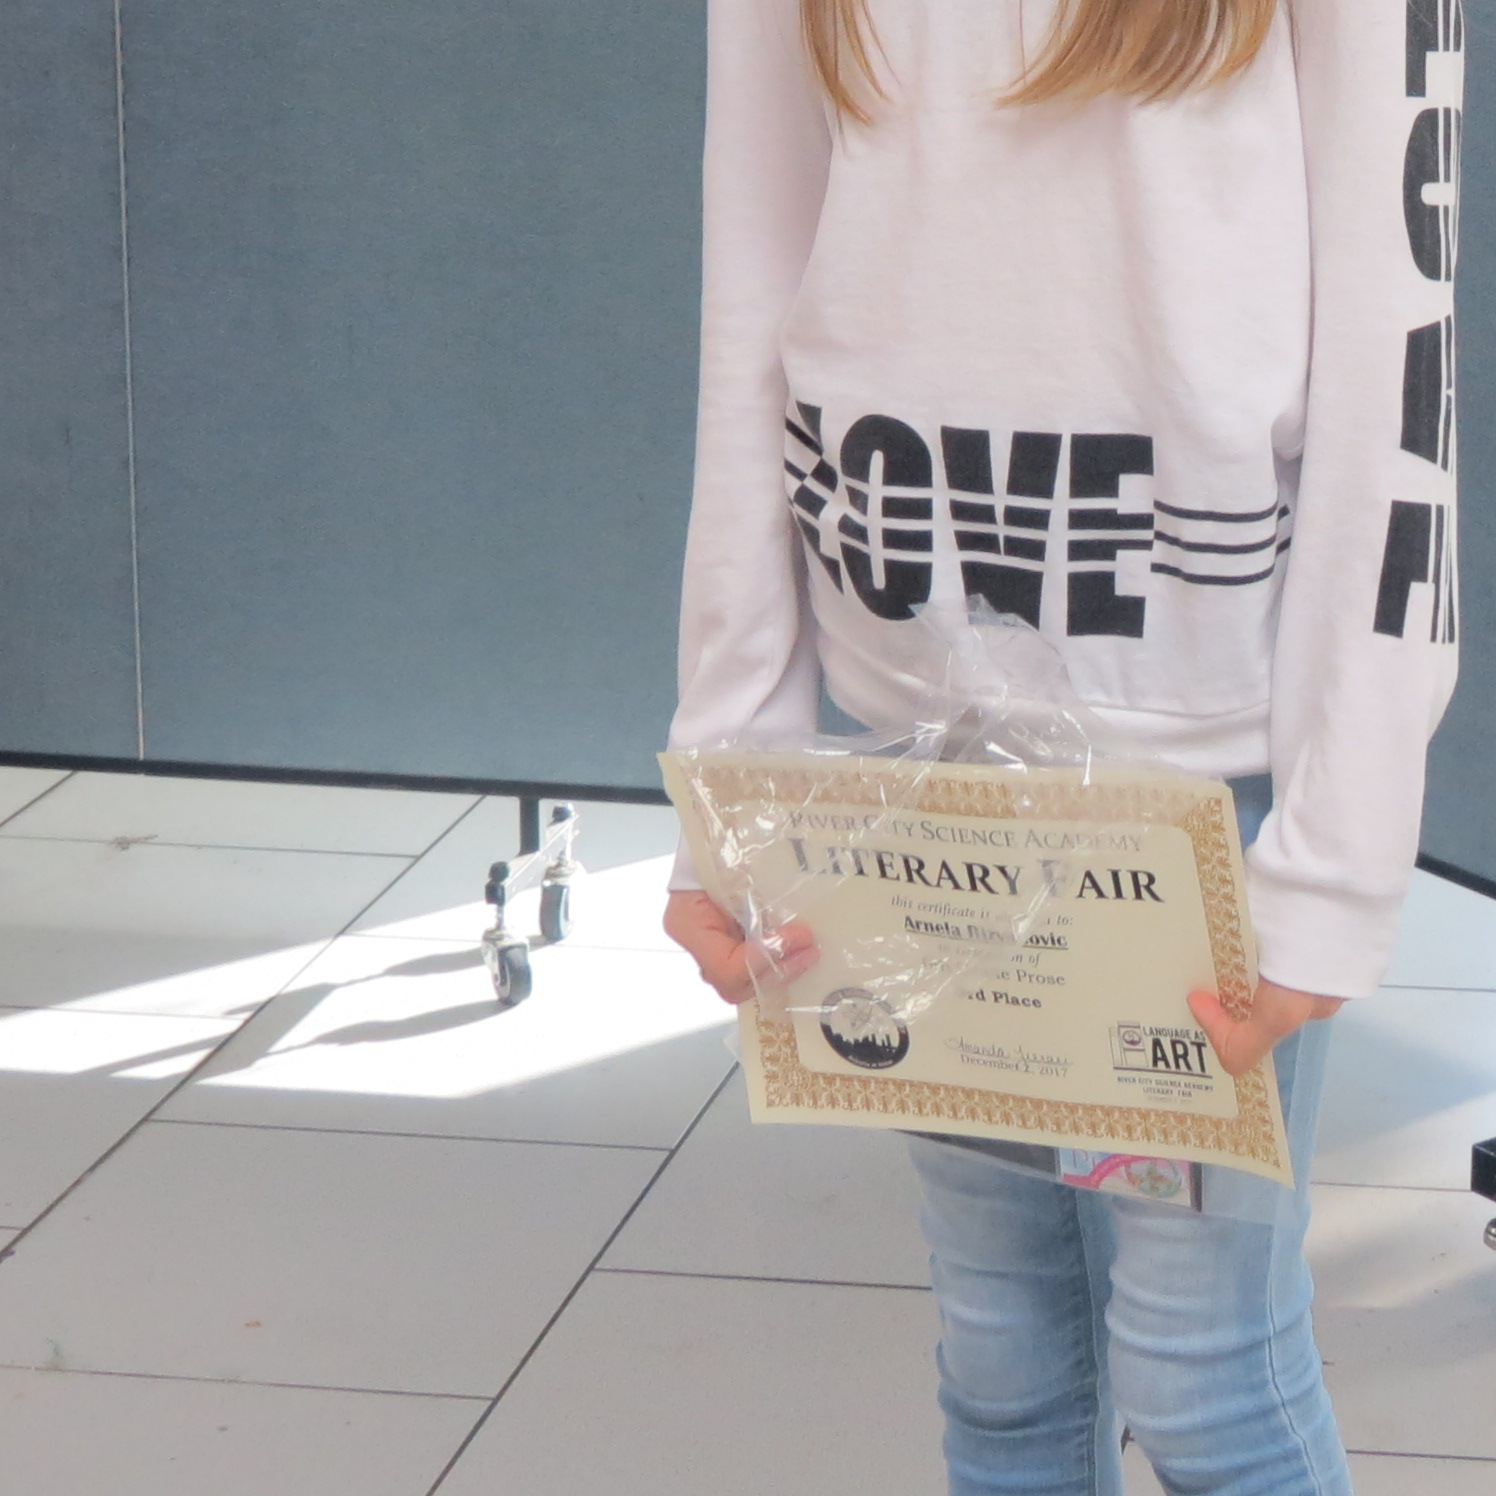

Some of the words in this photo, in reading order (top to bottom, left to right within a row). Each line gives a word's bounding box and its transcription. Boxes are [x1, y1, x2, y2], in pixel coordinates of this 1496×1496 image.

[891, 895, 913, 908] this
[917, 901, 976, 920] certificate
[1016, 969, 1067, 986] Prose
[991, 989, 1043, 1009] Place
[1142, 1025, 1192, 1040] LANGUAGE
[959, 1053, 1020, 1072] December
[1038, 1066, 1069, 1078] 2017
[1151, 1037, 1208, 1074] ART
